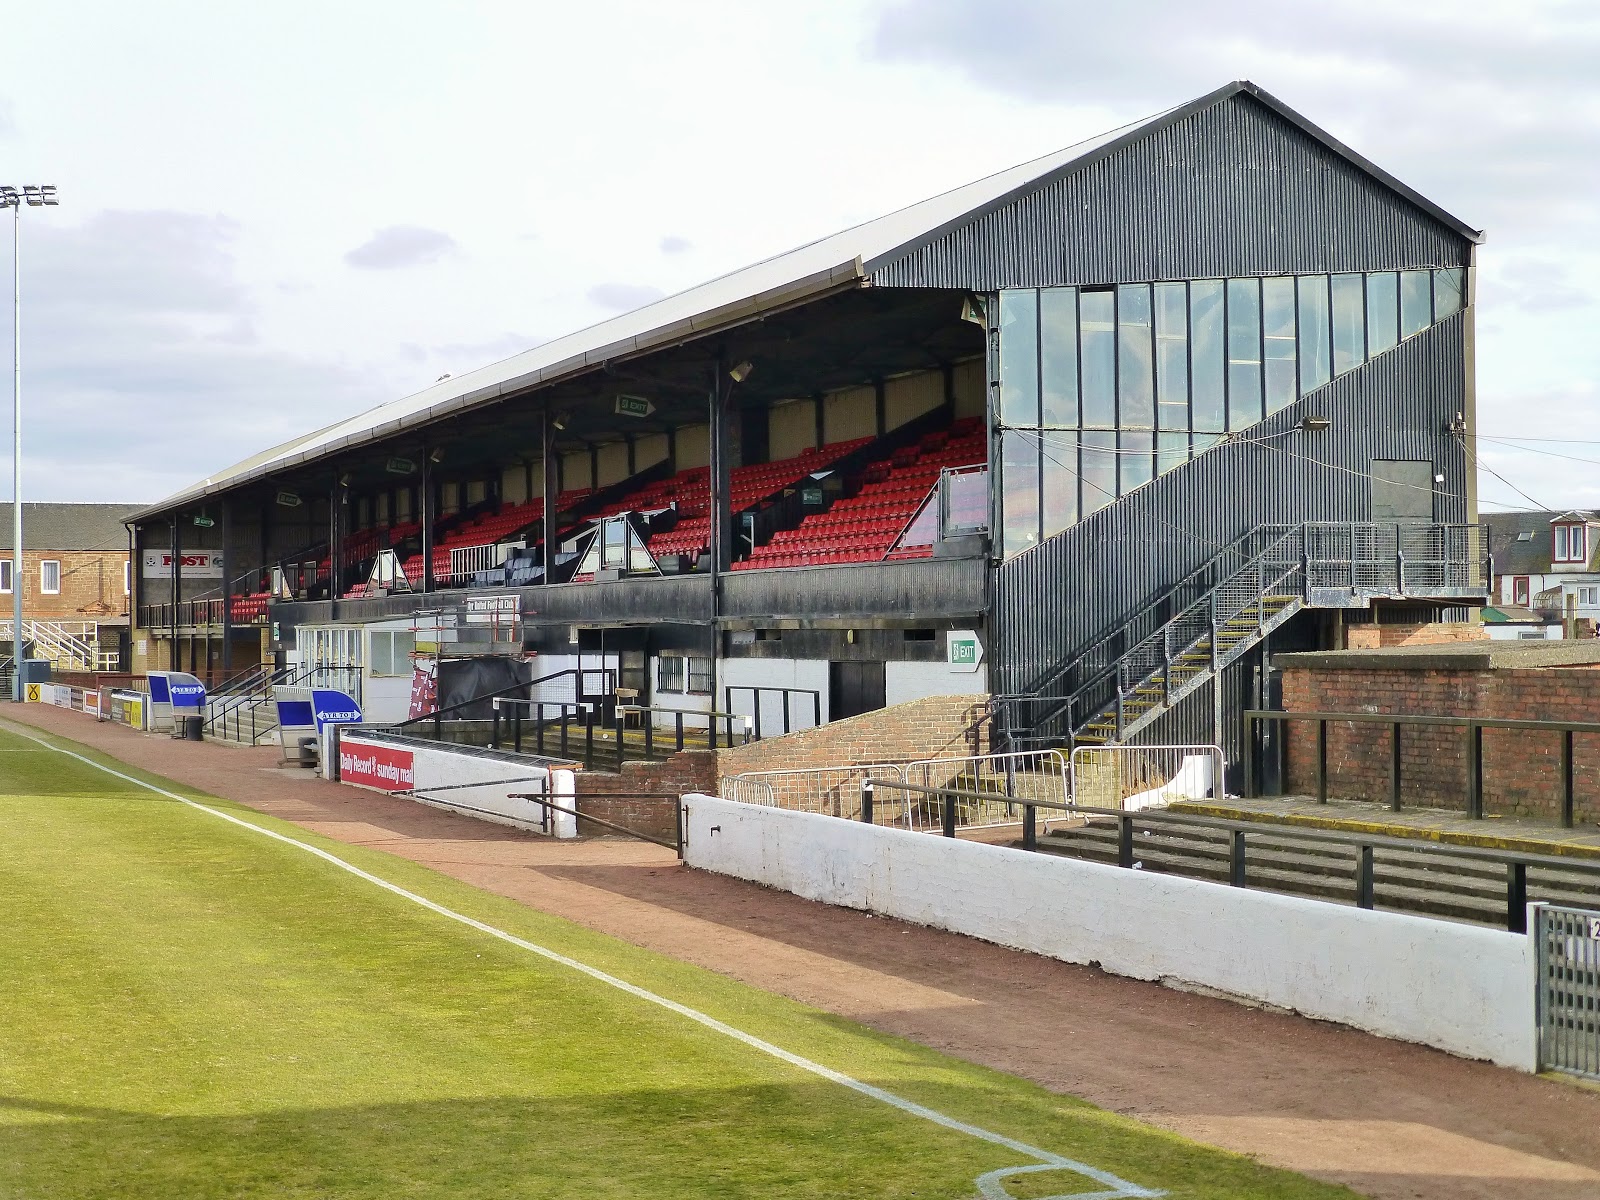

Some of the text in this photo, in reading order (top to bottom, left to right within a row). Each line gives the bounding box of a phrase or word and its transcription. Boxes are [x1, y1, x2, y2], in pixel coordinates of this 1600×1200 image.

[630, 402, 647, 411] EXIT
[960, 645, 974, 658] EXIT
[340, 752, 414, 785] Daily Record sunday mail
